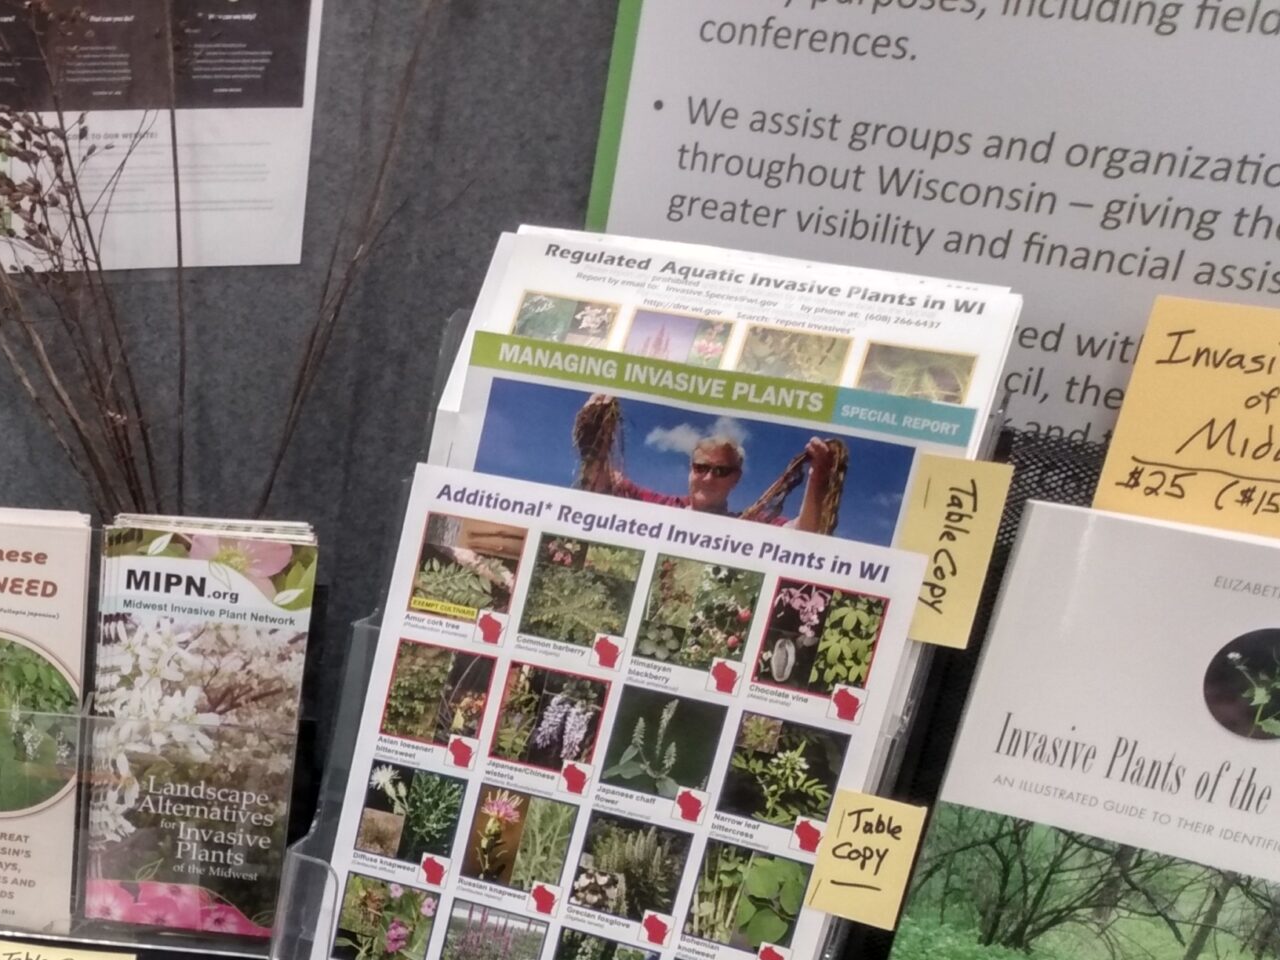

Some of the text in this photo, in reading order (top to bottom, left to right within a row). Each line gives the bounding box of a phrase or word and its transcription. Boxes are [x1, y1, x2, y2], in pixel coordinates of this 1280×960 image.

[700, 15, 918, 63] conferences.
[687, 95, 1051, 166] We assist groups and
[677, 142, 1222, 243] throughout Wisconsin giving
[666, 191, 1181, 283] greater visibility and financial
[545, 243, 987, 316] Regulated Aquatic Invasive Plants in WI
[499, 343, 825, 414] MANAGING INVASIVE PLANTS
[841, 404, 961, 436] SPECIAL REPORT
[1115, 468, 1197, 499] $25
[556, 502, 661, 540] Regulated
[666, 522, 753, 558] Invasive
[758, 540, 826, 573] Plants
[831, 553, 851, 576] in
[857, 557, 892, 585] WI
[917, 477, 977, 615] Table Copy
[125, 568, 240, 604] MIPN.org
[123, 599, 296, 627] Midwest Invasive Plant Network
[994, 712, 1273, 815] Invasive Plants of the
[137, 794, 275, 827] Alternatives
[147, 775, 269, 810] Landscape
[994, 774, 1213, 836] AN ILLUSTRATED GUIDE TO THEIR
[160, 819, 272, 850] for Invasive
[849, 807, 902, 840] Table
[175, 842, 244, 867] Plants
[185, 864, 258, 881] the Midwest
[9, 877, 36, 888] AND
